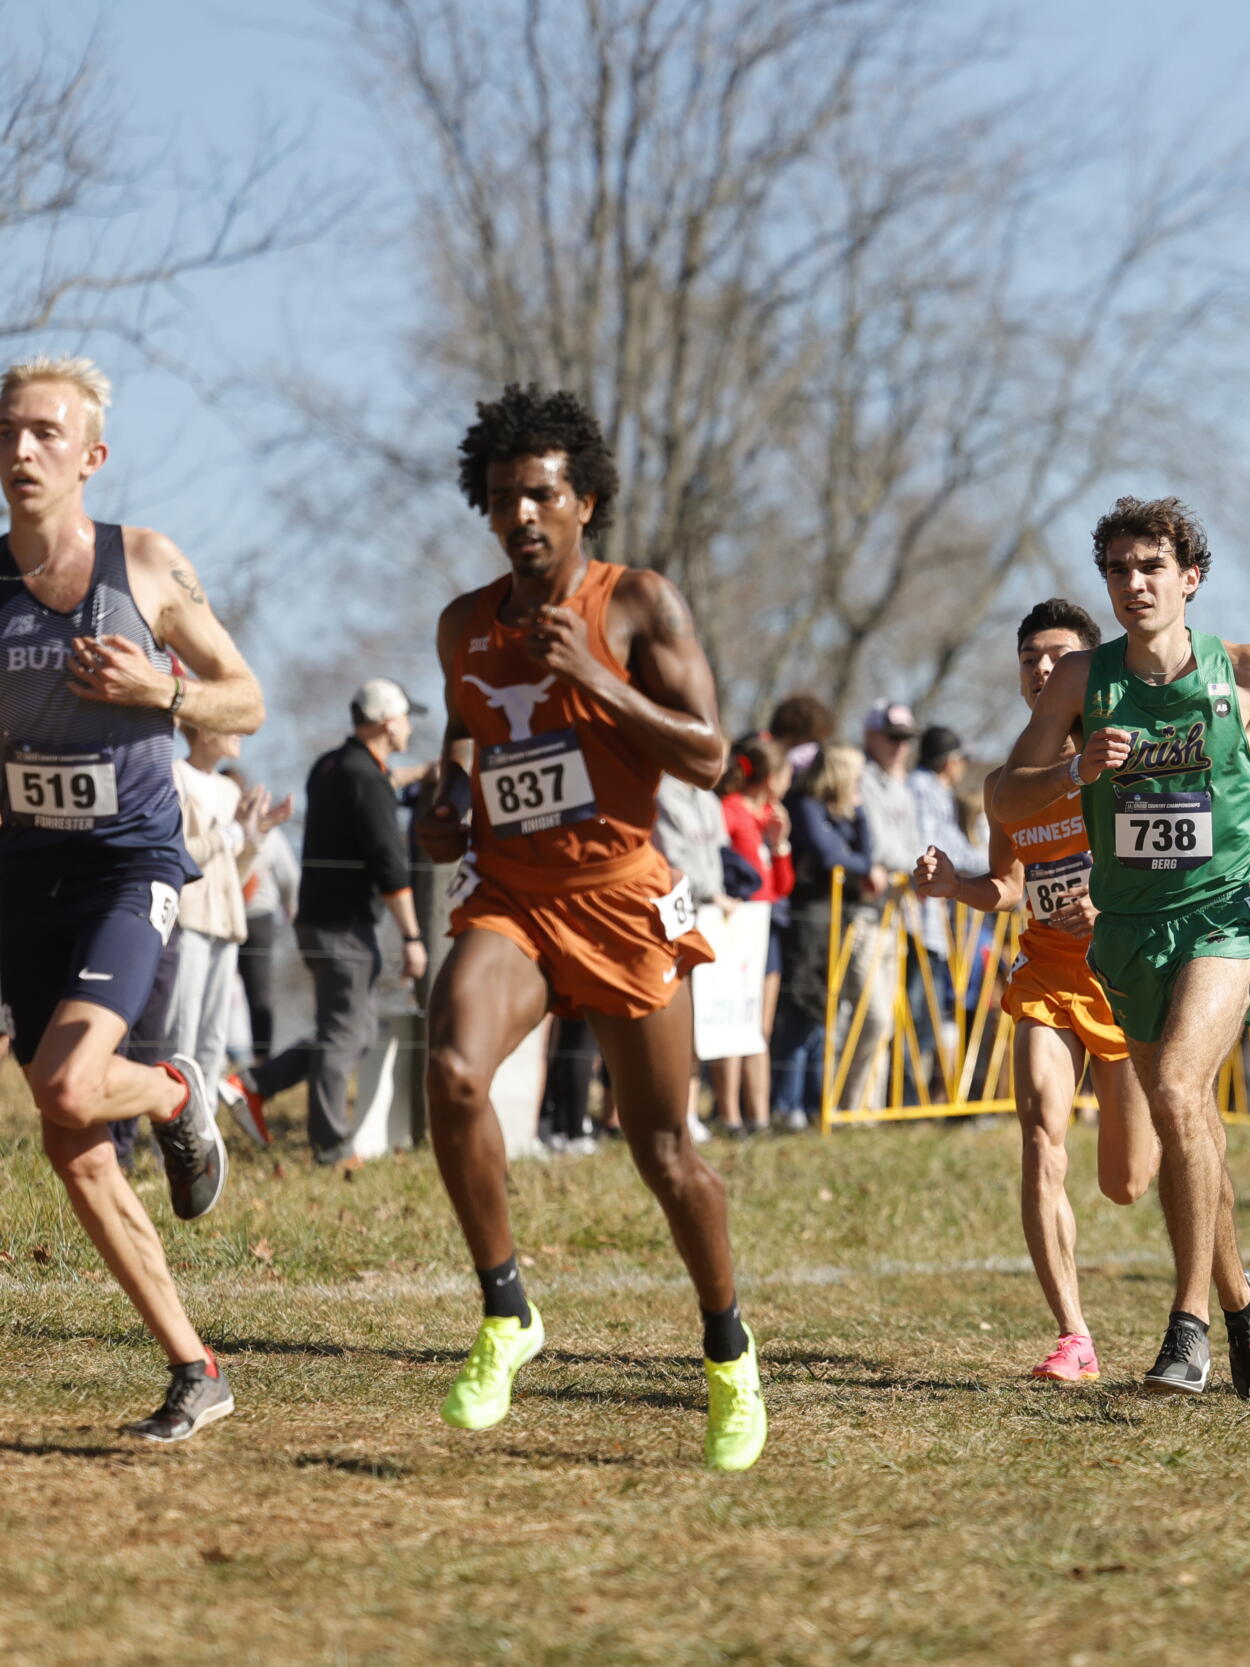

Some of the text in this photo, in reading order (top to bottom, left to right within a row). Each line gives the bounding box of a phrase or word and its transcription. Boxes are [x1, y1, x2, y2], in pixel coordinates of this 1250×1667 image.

[1216, 703, 1228, 712] AB
[1113, 721, 1213, 775] Irish
[23, 772, 96, 810] 519
[496, 763, 564, 814] 837
[1130, 819, 1197, 852] 738
[1151, 858, 1178, 870] BERG
